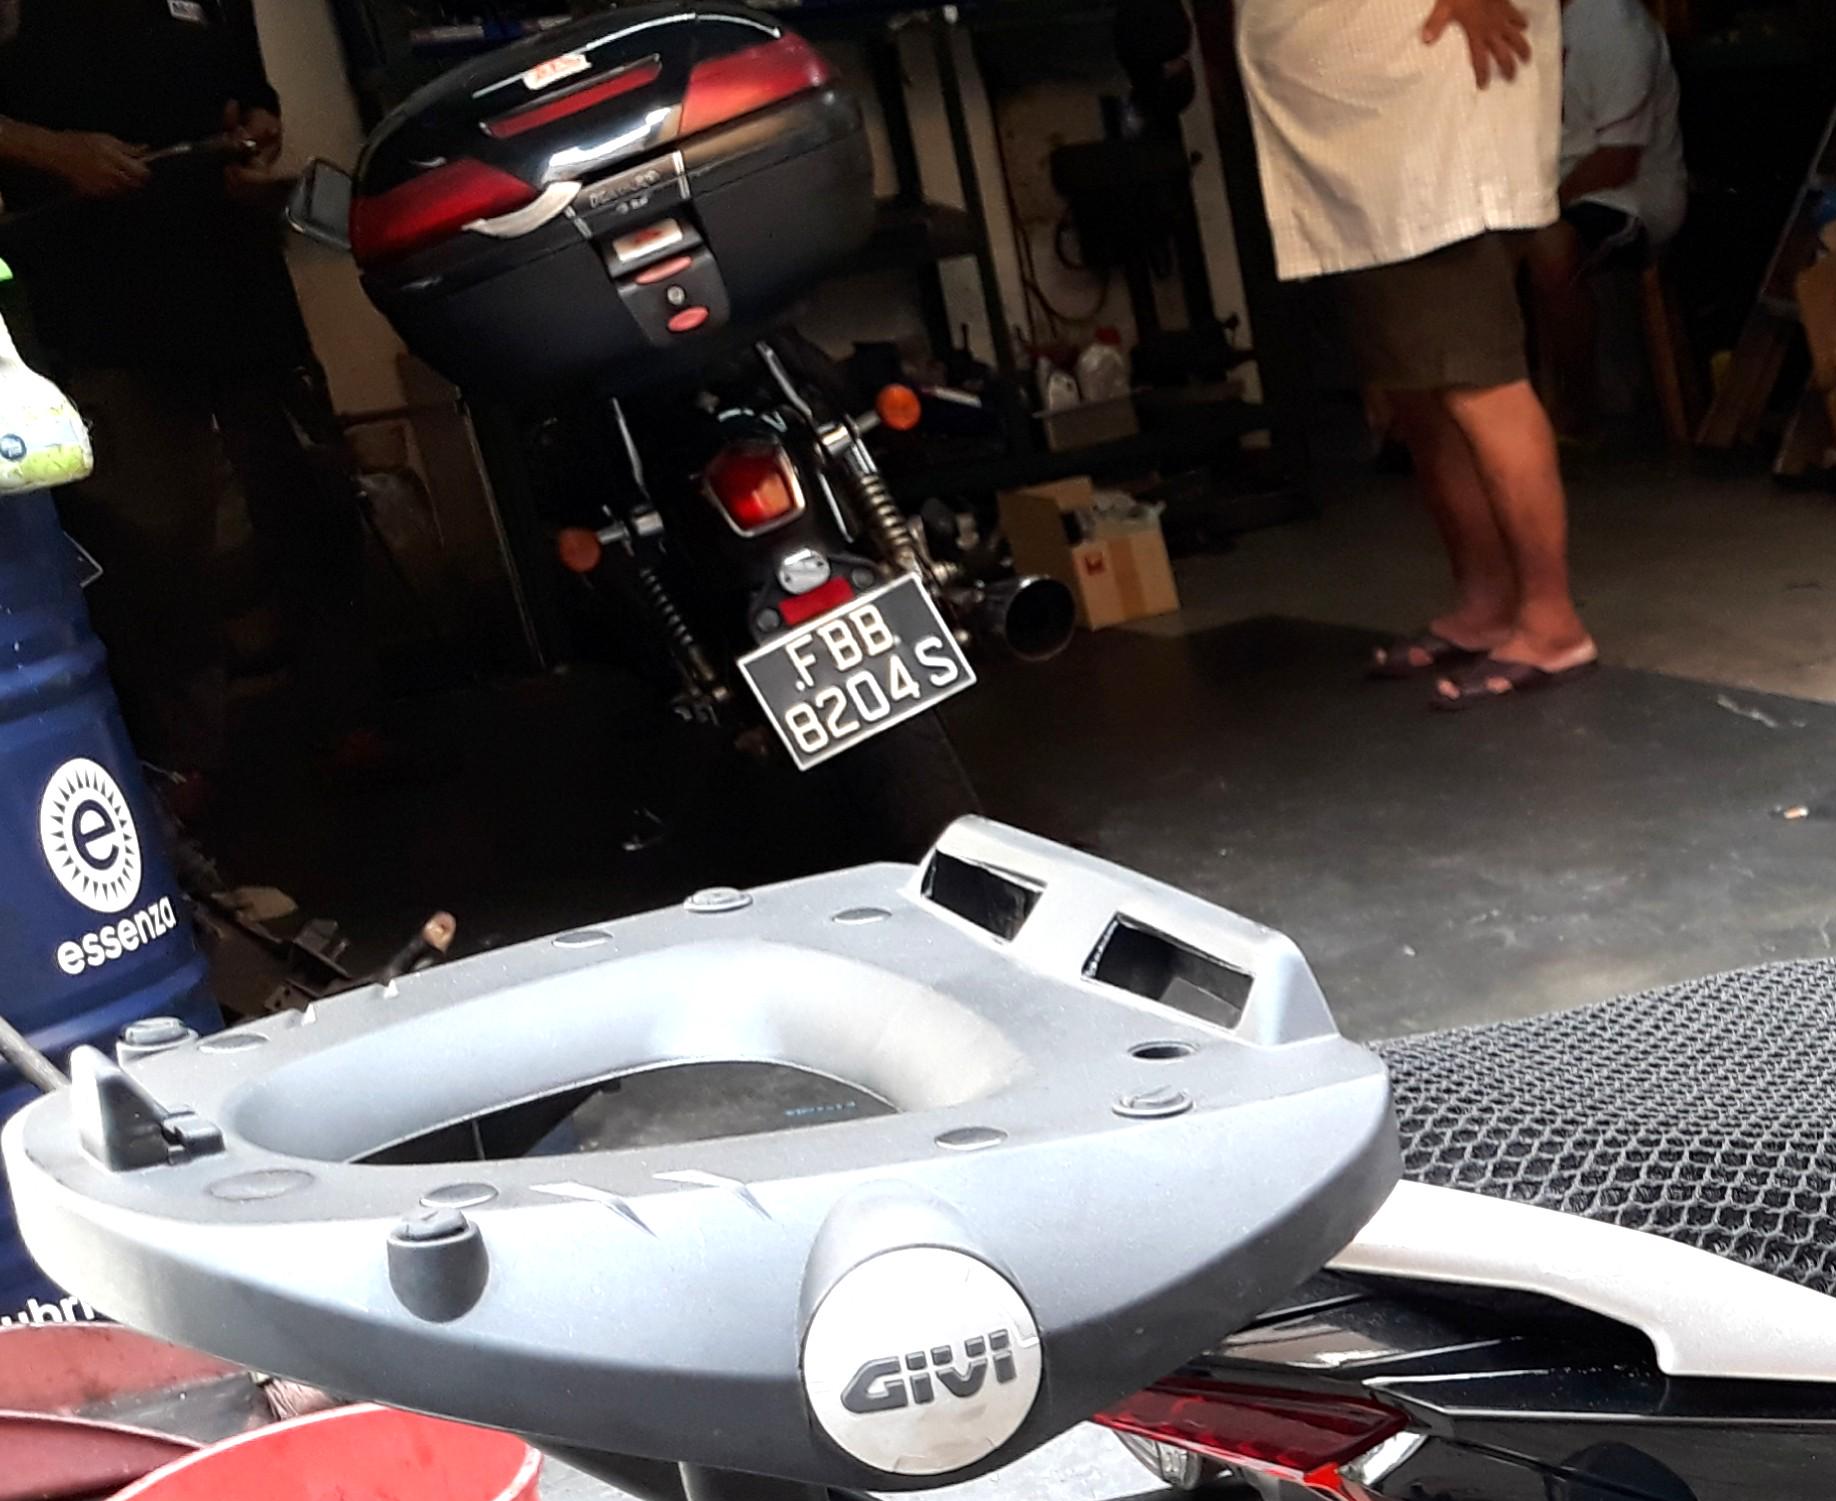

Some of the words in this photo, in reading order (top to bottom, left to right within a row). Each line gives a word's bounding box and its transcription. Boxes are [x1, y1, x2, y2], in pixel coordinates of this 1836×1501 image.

[785, 603, 895, 688] FBB
[57, 896, 177, 975] essenza
[840, 1328, 1017, 1415] GIVI
